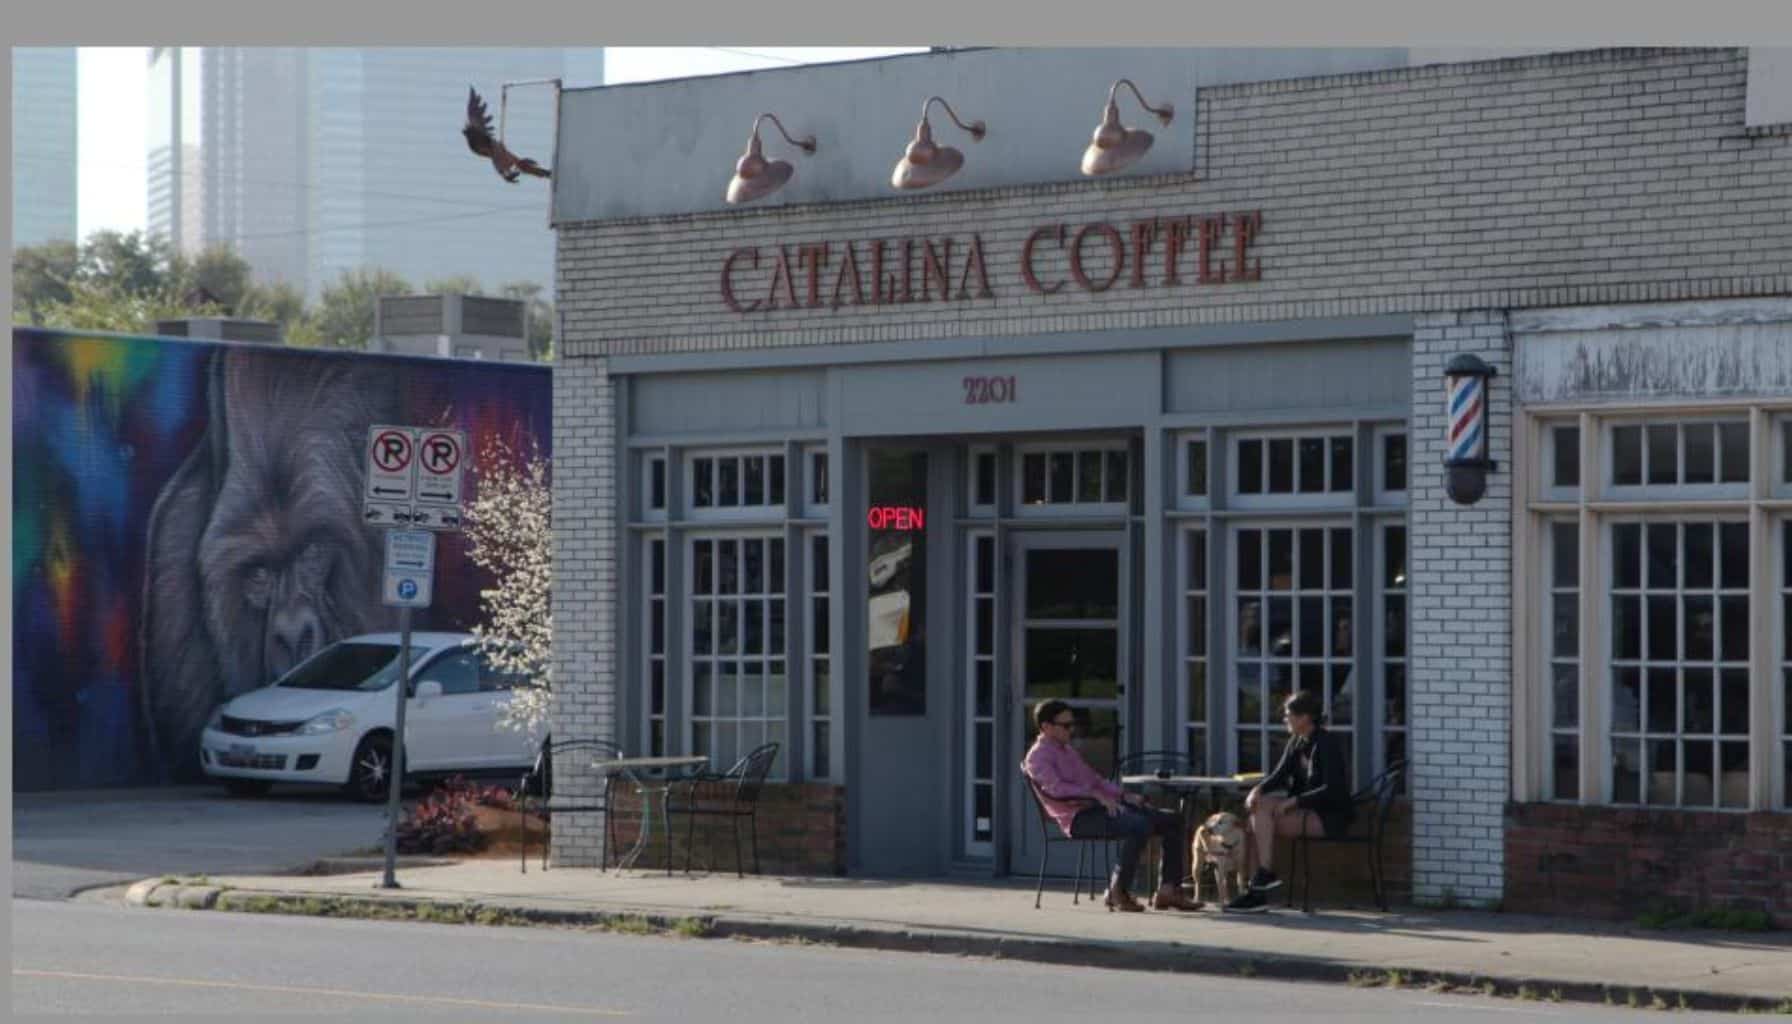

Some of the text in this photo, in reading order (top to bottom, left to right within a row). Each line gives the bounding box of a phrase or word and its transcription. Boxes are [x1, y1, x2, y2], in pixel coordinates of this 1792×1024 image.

[720, 210, 1262, 314] CATALINA COFFEE
[963, 376, 1016, 404] 2201
[867, 506, 923, 529] OPEN
